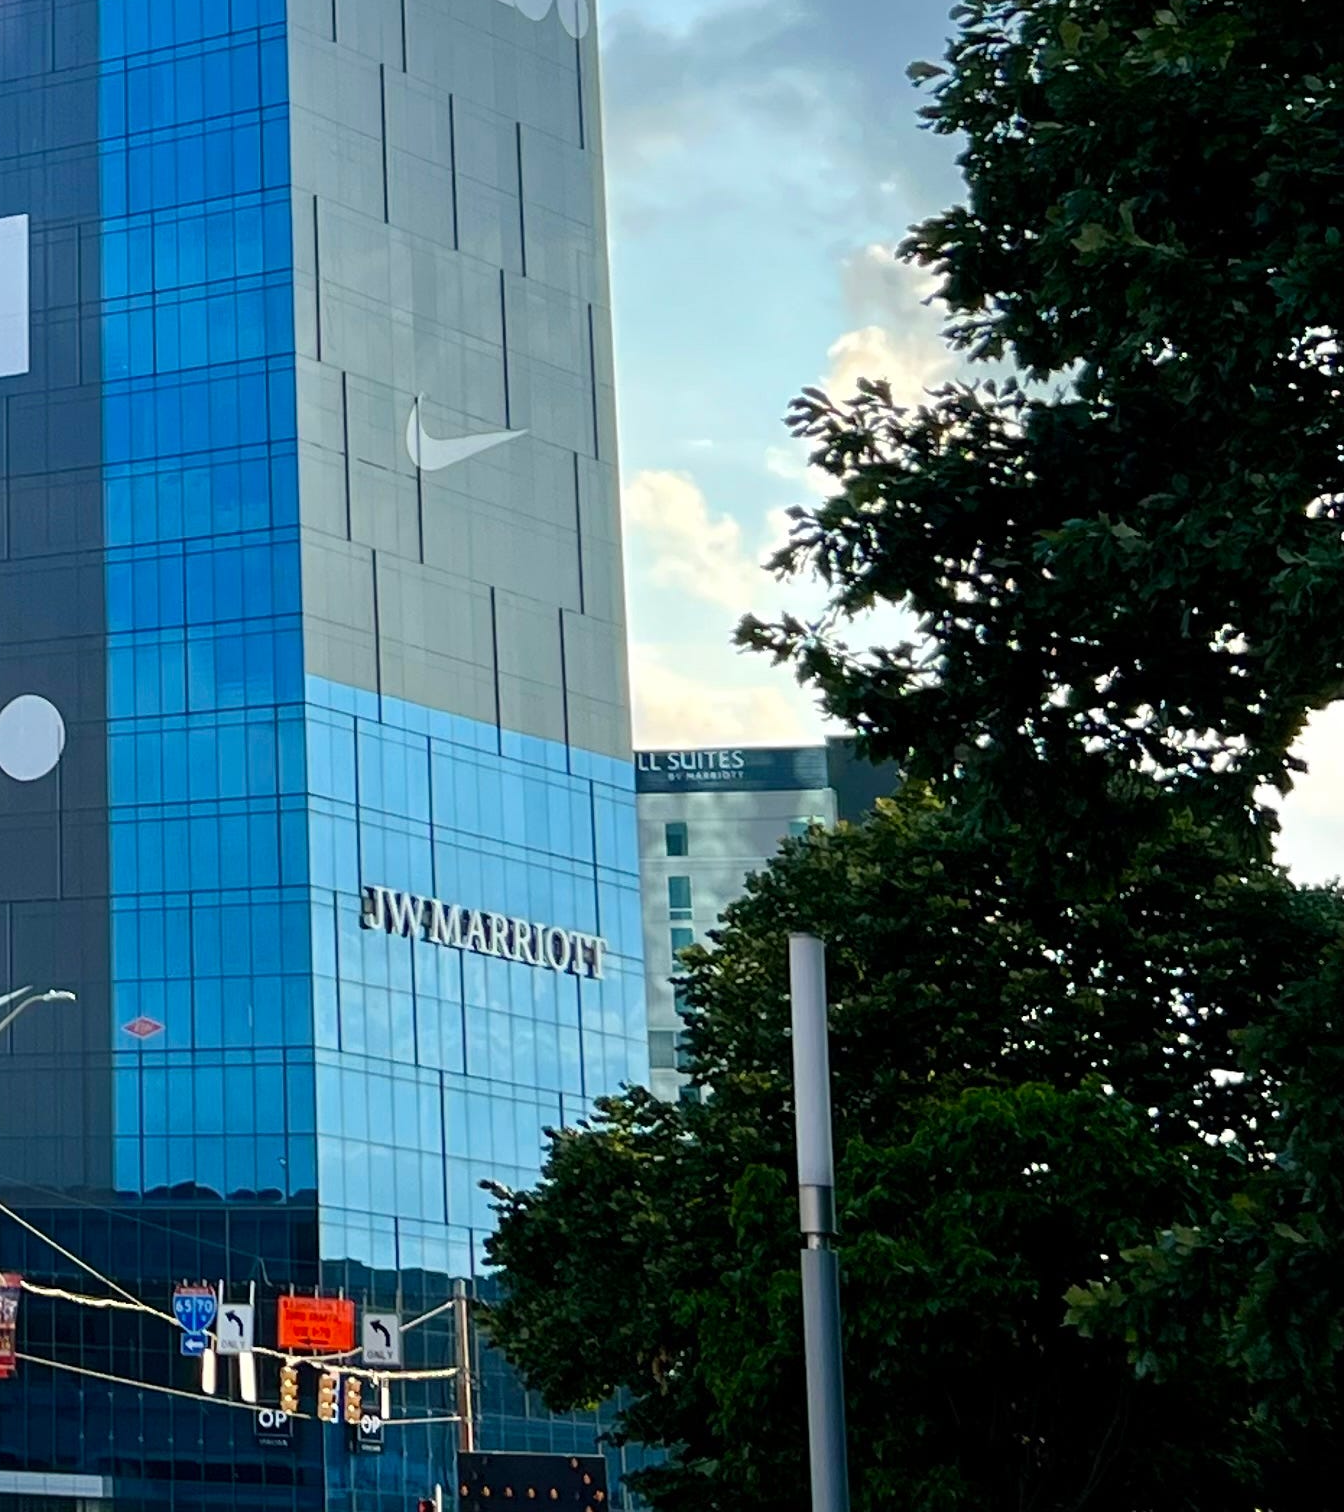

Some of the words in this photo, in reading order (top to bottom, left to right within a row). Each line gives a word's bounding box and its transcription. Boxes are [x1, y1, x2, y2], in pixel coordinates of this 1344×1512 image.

[667, 750, 745, 770] SUITES
[685, 770, 745, 781] MARRIOTT
[362, 885, 426, 938] JW
[428, 897, 609, 980] MARRIOTT
[175, 1298, 192, 1313] 65
[196, 1298, 213, 1314] 70
[366, 1349, 394, 1360] ONLY
[258, 1409, 288, 1429] OP
